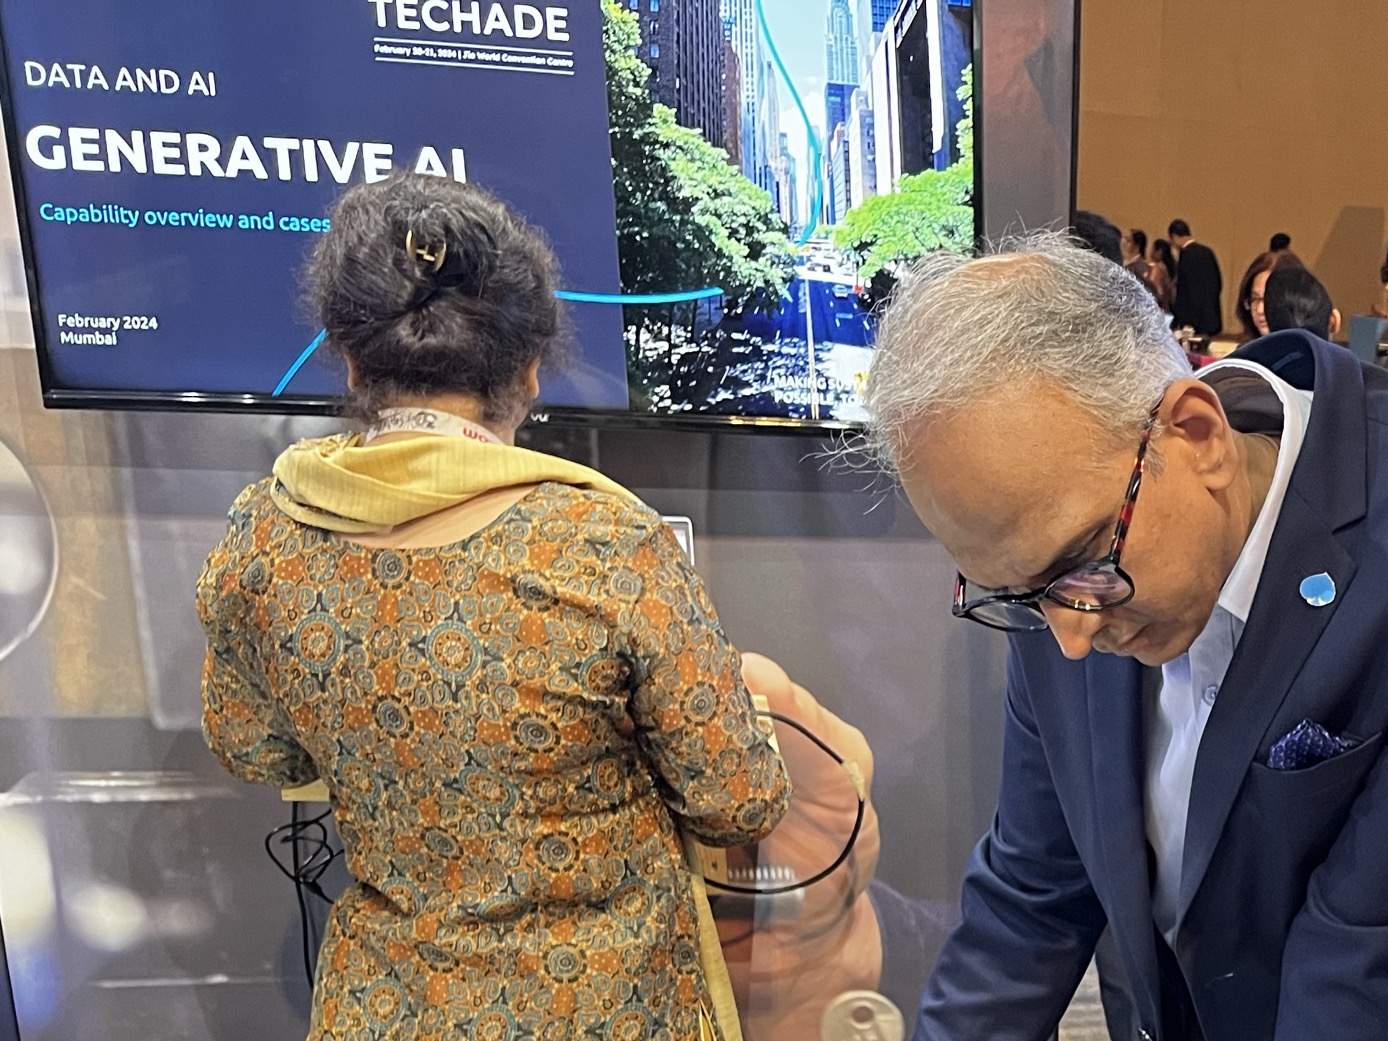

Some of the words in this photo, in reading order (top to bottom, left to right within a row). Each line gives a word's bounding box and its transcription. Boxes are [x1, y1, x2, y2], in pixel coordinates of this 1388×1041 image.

[367, 0, 570, 42] TECHADE
[24, 61, 109, 90] DATA
[115, 67, 180, 94] AND
[188, 71, 217, 97] AI
[25, 125, 393, 184] GENERATIVE
[414, 146, 466, 184] AI
[40, 203, 140, 228] Capability
[144, 208, 234, 229] overview
[238, 211, 274, 231] and
[279, 216, 332, 233] cases
[58, 313, 120, 331] February
[123, 316, 158, 330] 2024
[60, 331, 117, 345] Mumbai
